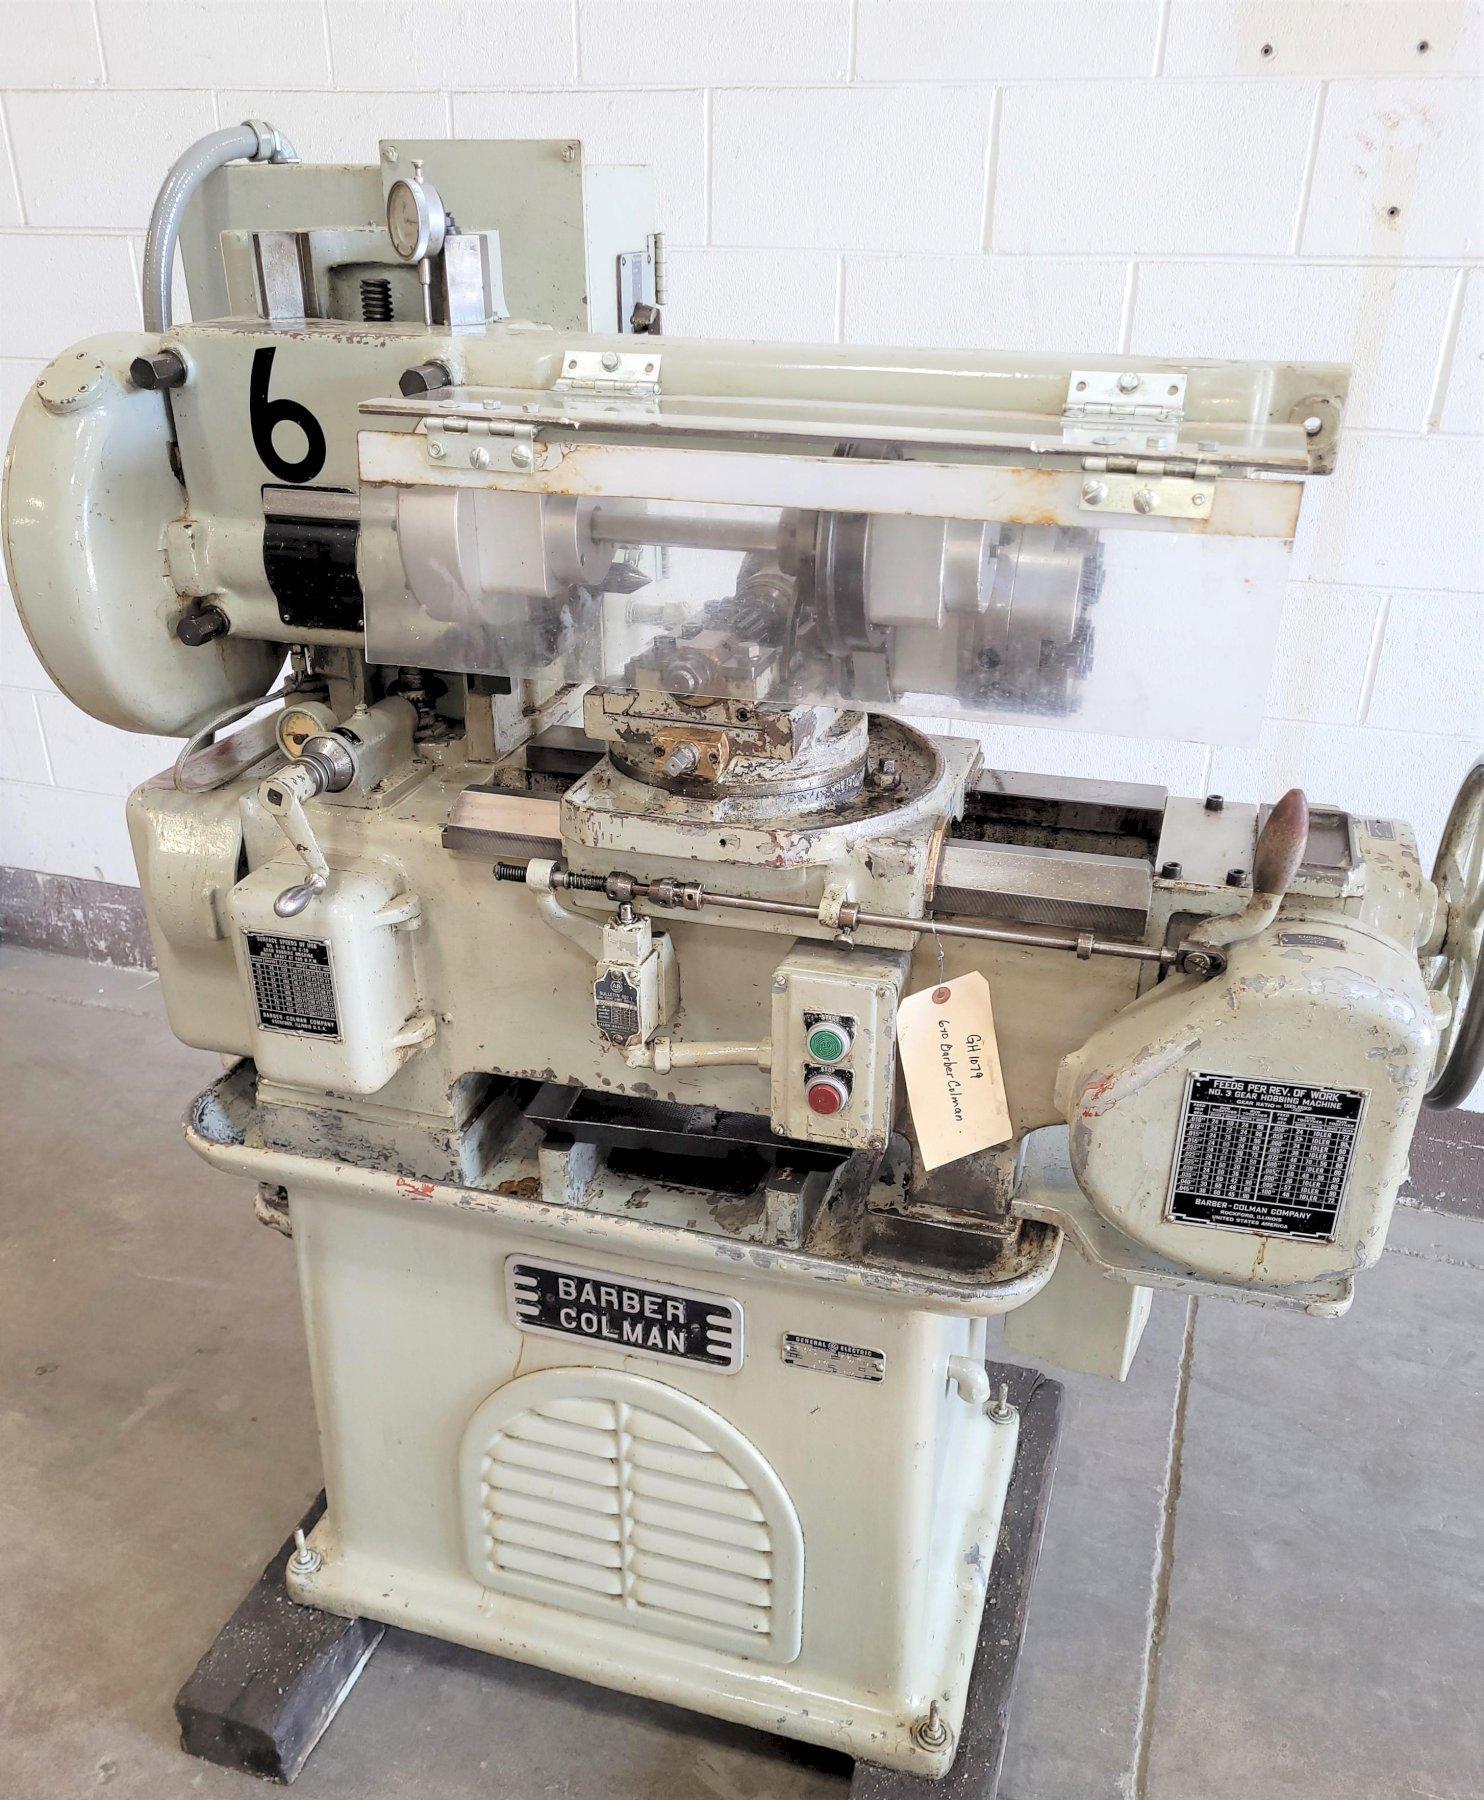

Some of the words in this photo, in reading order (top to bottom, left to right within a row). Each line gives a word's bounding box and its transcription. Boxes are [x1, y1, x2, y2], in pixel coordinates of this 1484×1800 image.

[250, 347, 327, 484] 6
[1207, 1088, 1223, 1096] NO.
[1234, 1091, 1257, 1099] GEAR
[1260, 1094, 1299, 1104] HOBBING
[1301, 1098, 1342, 1109] MACHINE
[1213, 1079, 1244, 1090] FEEDS
[1247, 1083, 1267, 1093] PER
[1268, 1085, 1291, 1096] REV.
[1292, 1088, 1307, 1097] OF
[1309, 1090, 1340, 1101] WORK
[1311, 1137, 1330, 1145] IDLER
[1313, 1130, 1331, 1138] IDLER
[1299, 1193, 1317, 1201] IDLER
[1270, 1207, 1311, 1219] COMPANY
[1260, 1220, 1288, 1229] AMERICA
[558, 1277, 685, 1324] BARBER
[559, 1308, 685, 1353] COLMAN
[795, 1336, 826, 1348] GENERAL
[840, 1345, 873, 1357] ELECTRIC
